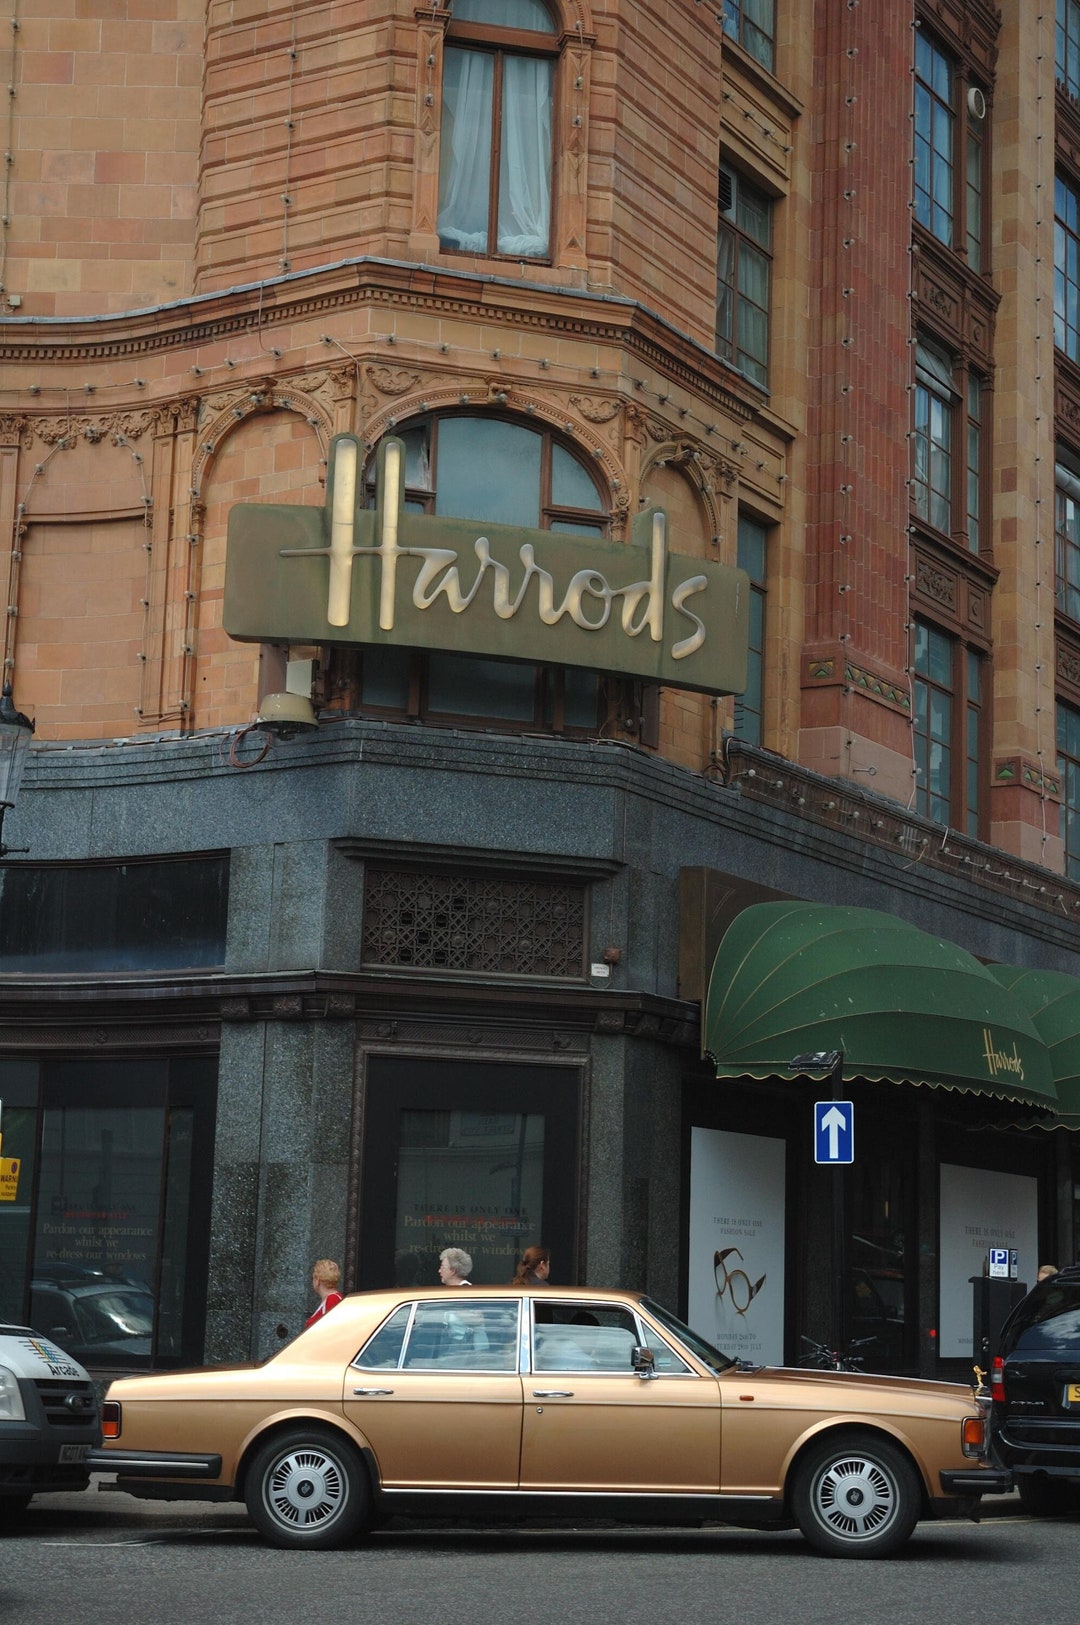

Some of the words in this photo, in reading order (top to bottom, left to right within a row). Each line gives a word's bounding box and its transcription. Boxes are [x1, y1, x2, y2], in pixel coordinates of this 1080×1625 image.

[280, 438, 707, 660] Harrods
[982, 1028, 1024, 1080] Harrods
[404, 1215, 444, 1228] Pardon
[448, 1219, 467, 1228] our
[471, 1219, 536, 1232] appearance
[43, 1223, 76, 1234] Pardon
[79, 1227, 95, 1235] our
[98, 1226, 153, 1239] appearance
[443, 1230, 477, 1241] whilst
[481, 1233, 496, 1241] we
[74, 1236, 102, 1247] whilst
[105, 1239, 119, 1247] we
[105, 1249, 146, 1260] windows
[482, 1244, 527, 1256] window
[994, 1251, 1005, 1264] P
[47, 1363, 80, 1377] Arcade
